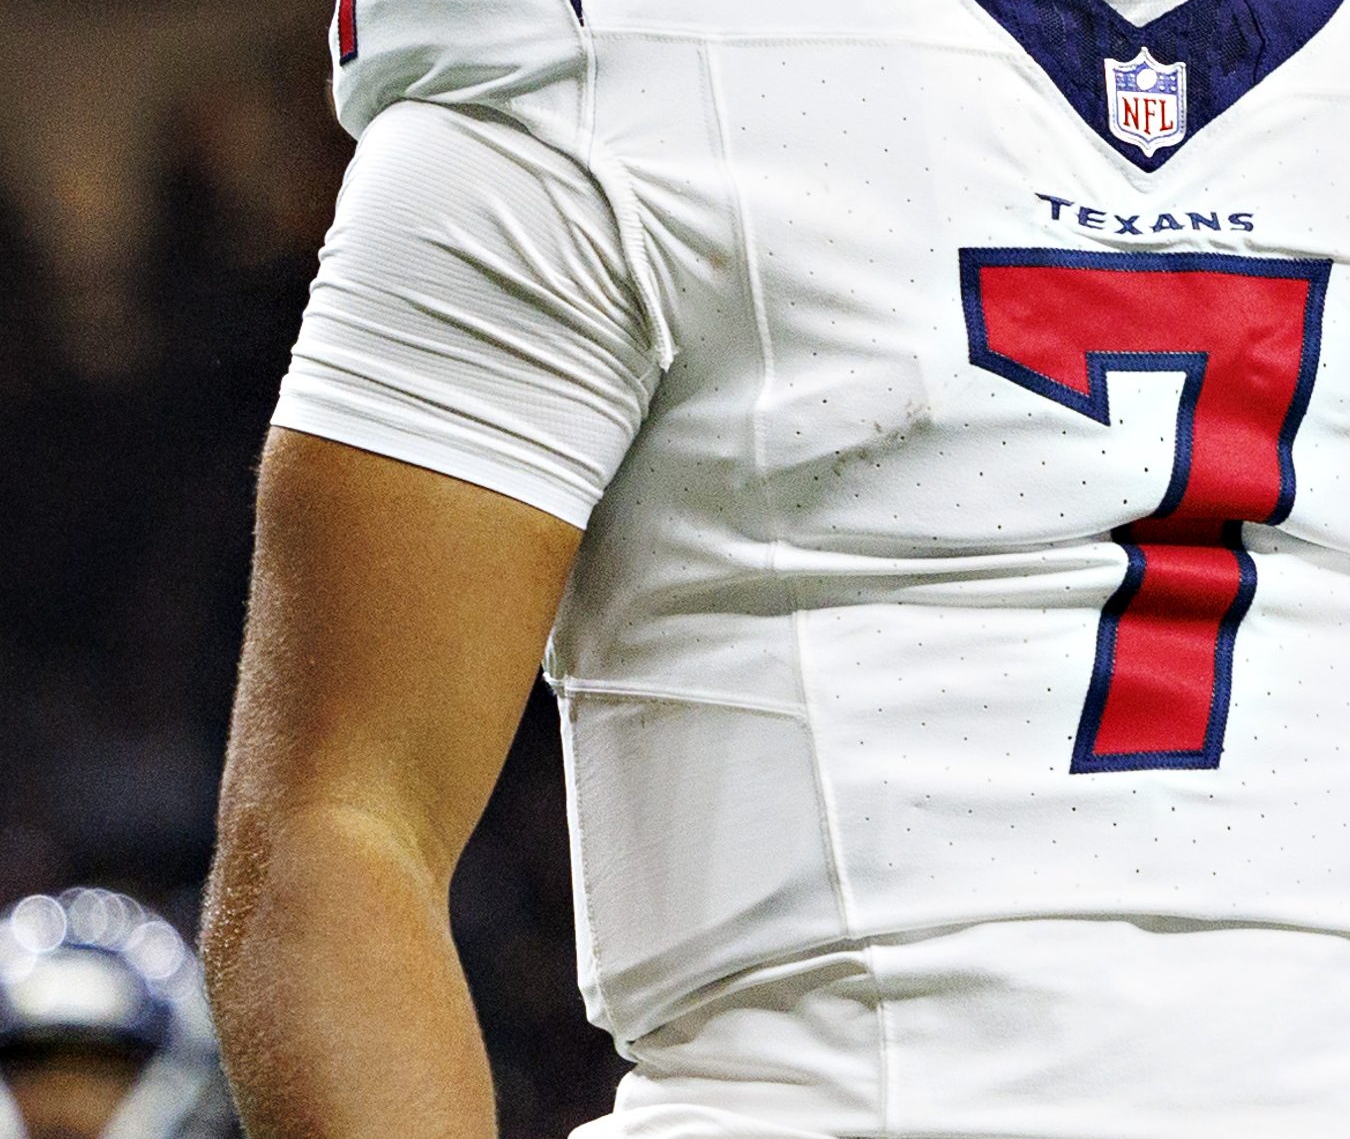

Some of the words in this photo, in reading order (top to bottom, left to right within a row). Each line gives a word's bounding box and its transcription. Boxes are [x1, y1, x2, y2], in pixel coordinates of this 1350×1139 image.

[1122, 96, 1174, 135] NFL
[1034, 192, 1254, 236] TEXANS
[958, 247, 1333, 775] 7
